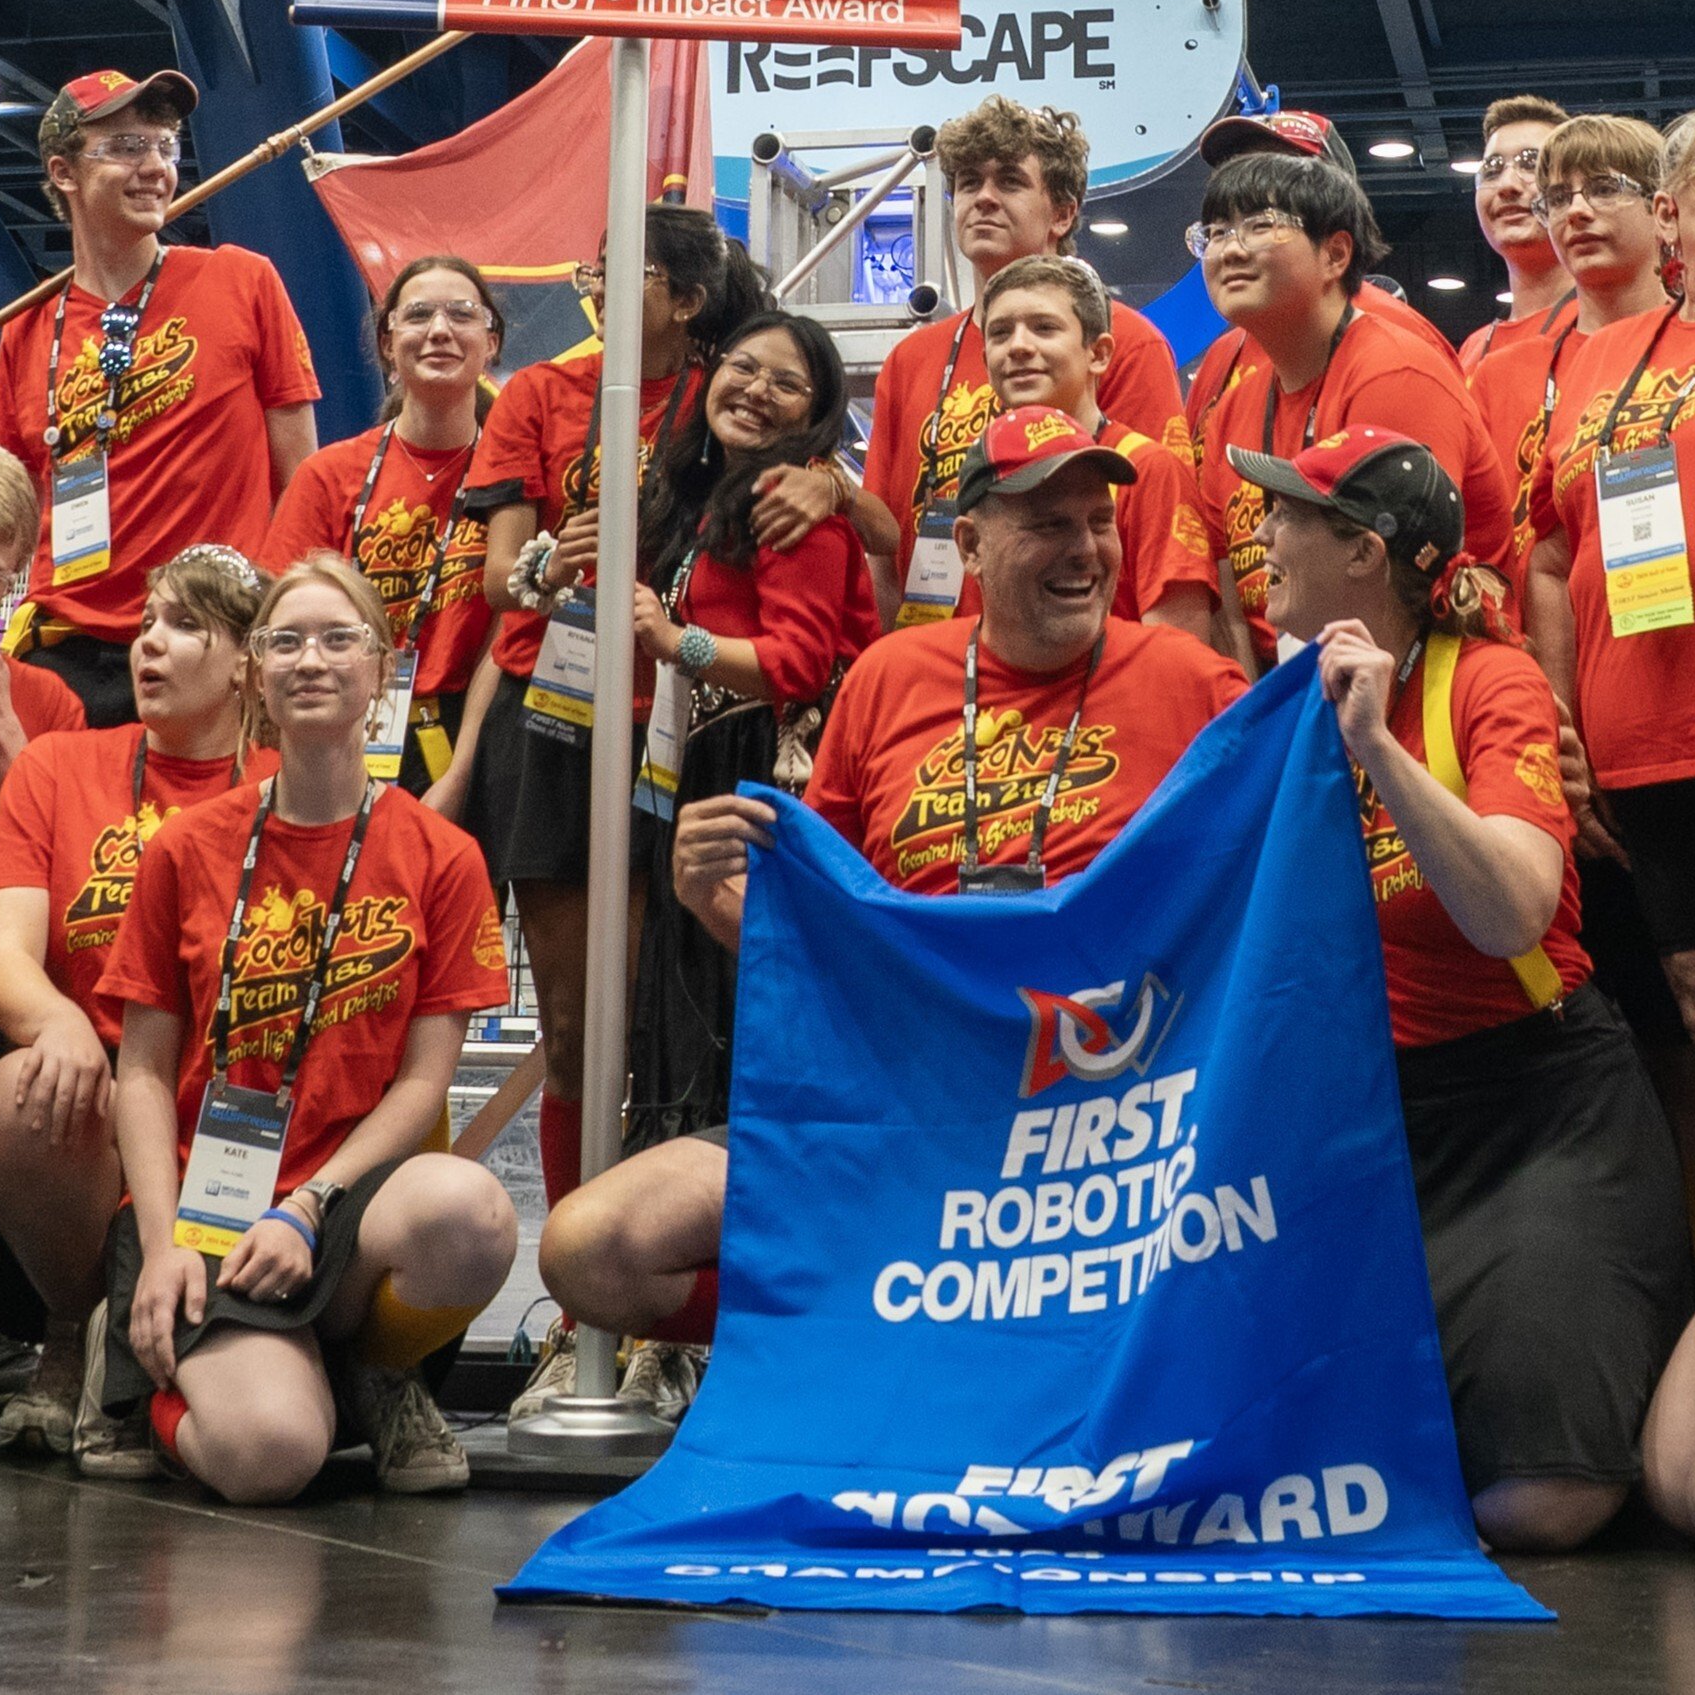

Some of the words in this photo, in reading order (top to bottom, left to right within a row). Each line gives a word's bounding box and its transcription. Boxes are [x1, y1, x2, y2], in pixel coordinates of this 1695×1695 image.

[1626, 494, 1655, 507] SUSAN
[1000, 1067, 1197, 1180] FIRST
[223, 1145, 249, 1160] KATE
